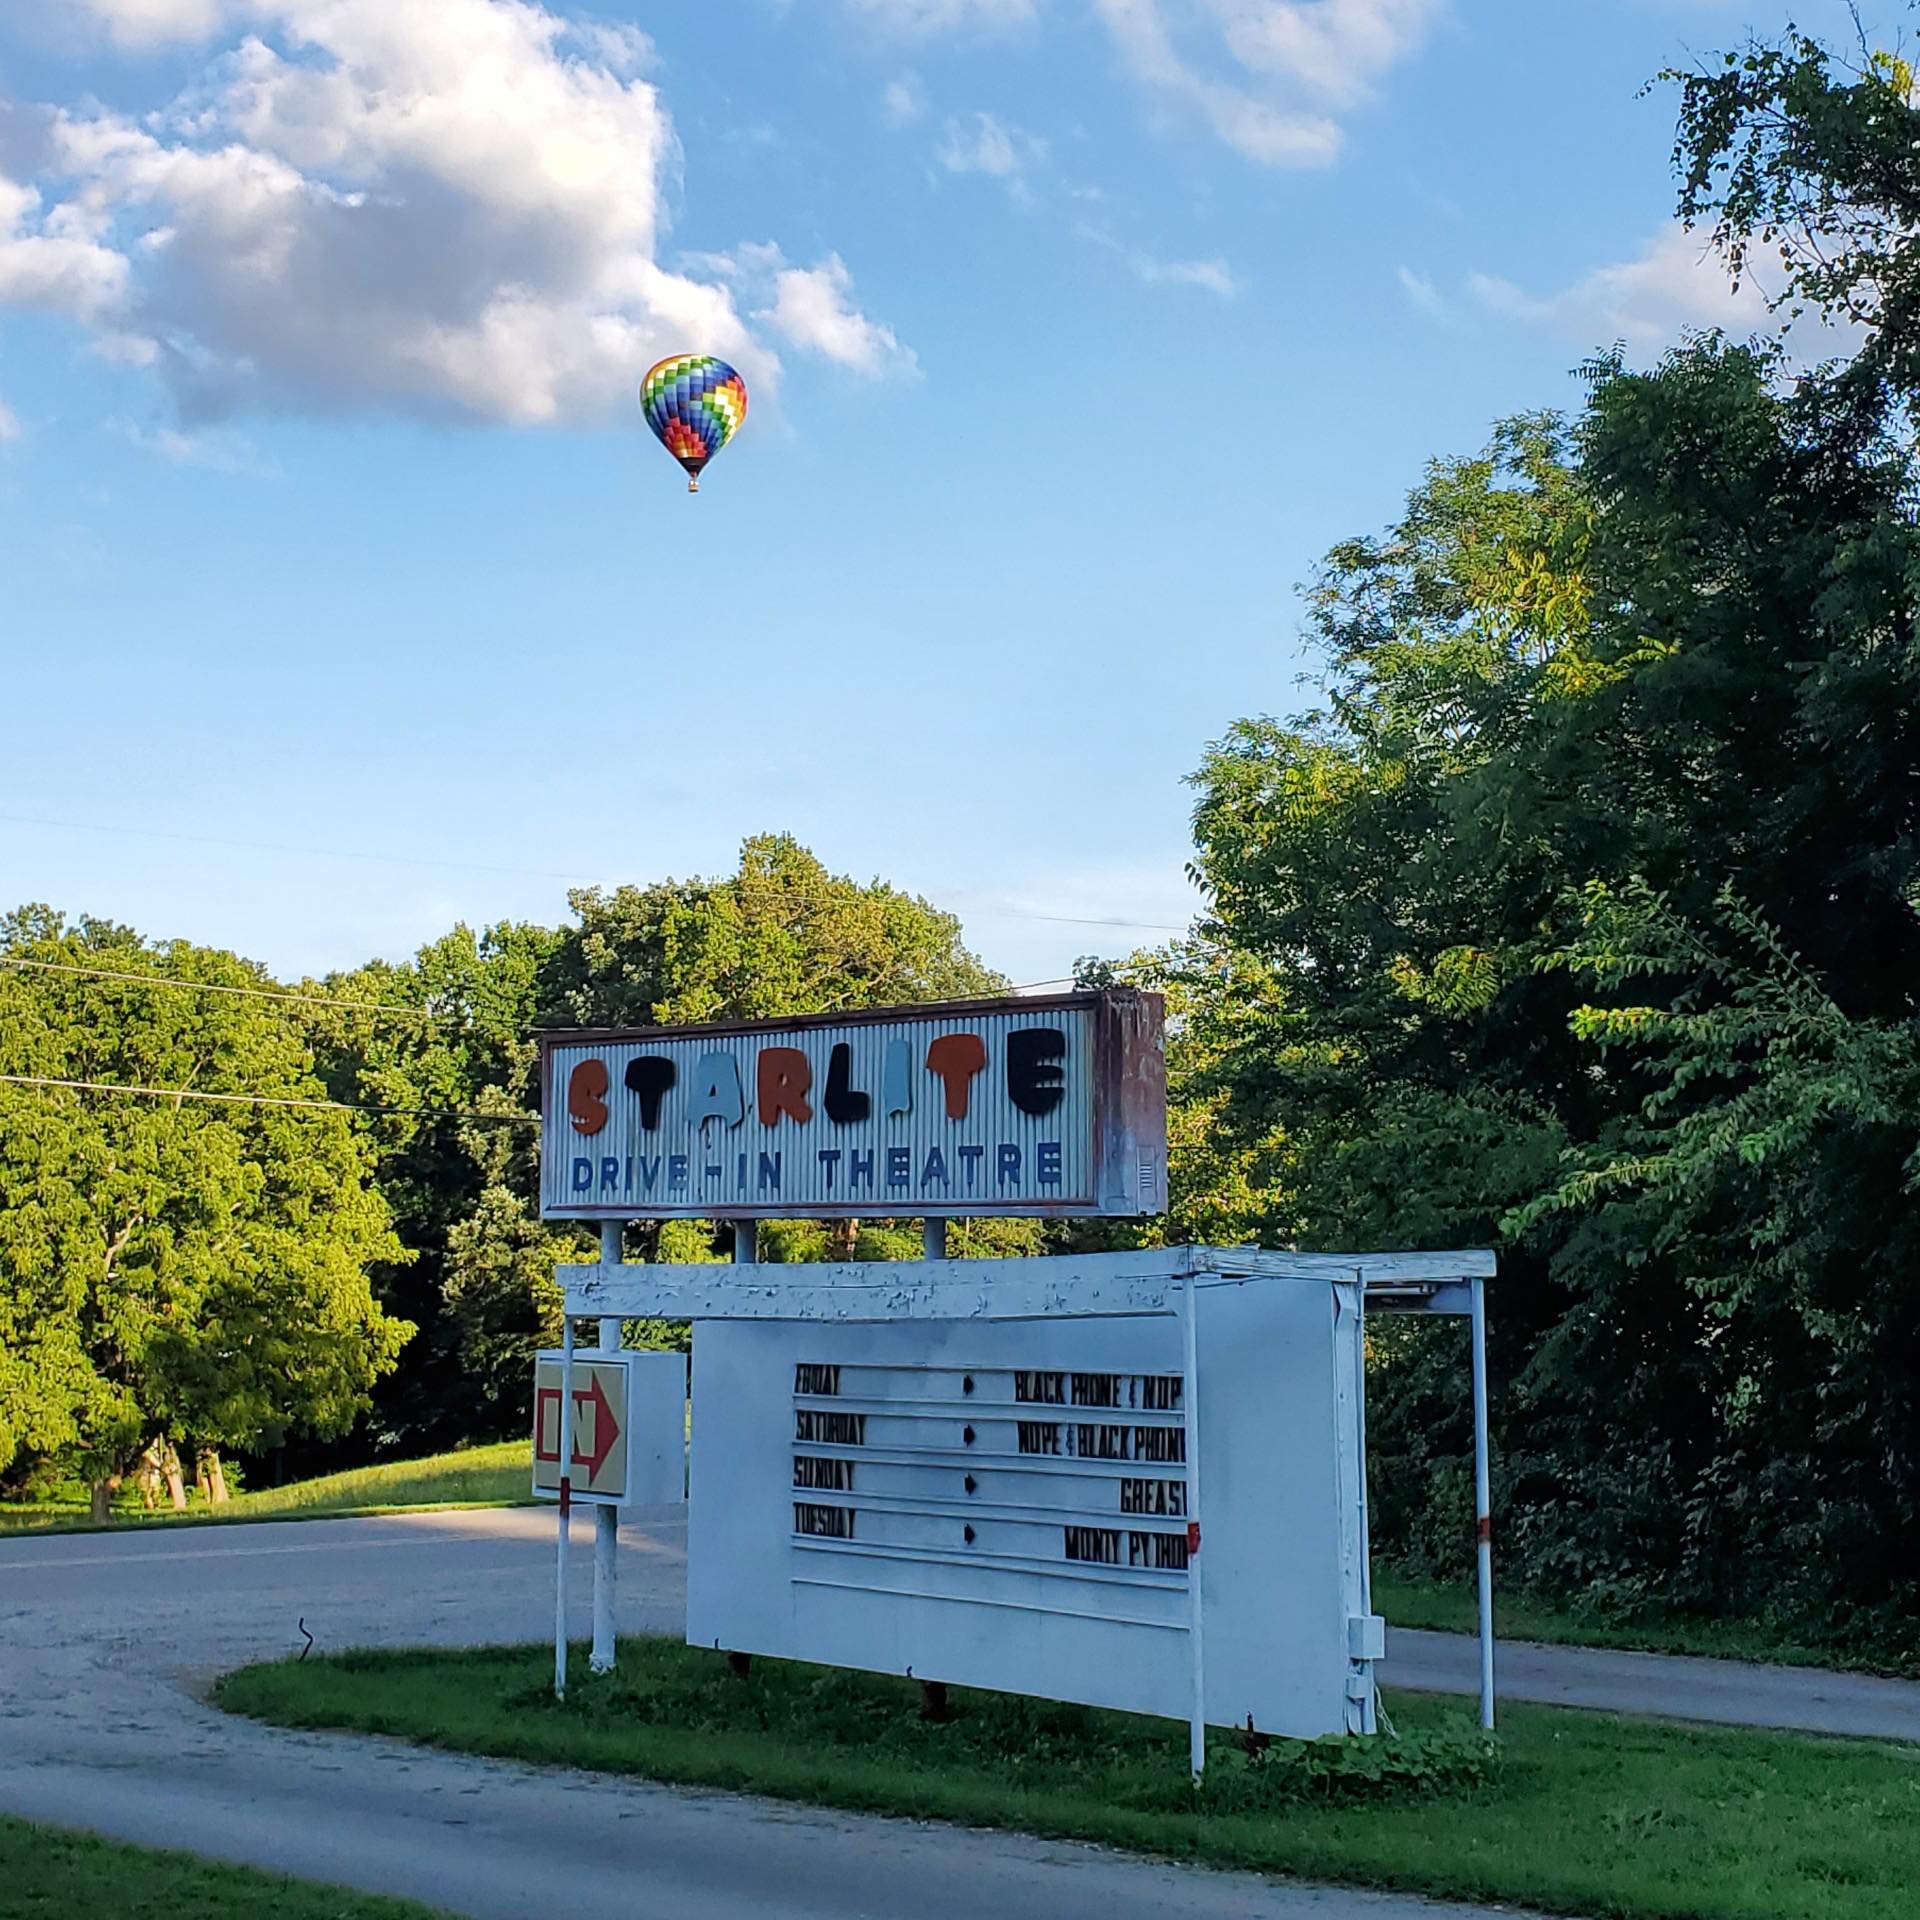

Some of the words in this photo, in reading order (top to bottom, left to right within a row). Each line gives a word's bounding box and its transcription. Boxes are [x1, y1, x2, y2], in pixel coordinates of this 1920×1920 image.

[568, 1027, 1066, 1135] STARLITE
[572, 1151, 782, 1192] DRIVE-IN
[818, 1141, 1063, 1188] THEATRE
[794, 1363, 840, 1395] FRIDAY
[1014, 1371, 1066, 1404] BLACK
[1071, 1374, 1121, 1407] PHONE
[542, 1397, 597, 1458] IN
[795, 1409, 866, 1445] SATURDAY
[1017, 1421, 1062, 1455] NOPE
[1077, 1424, 1130, 1460] BLACK
[793, 1456, 854, 1491] SUNDAY
[793, 1502, 856, 1539] TUESDAY
[1064, 1526, 1121, 1565] MONTY
